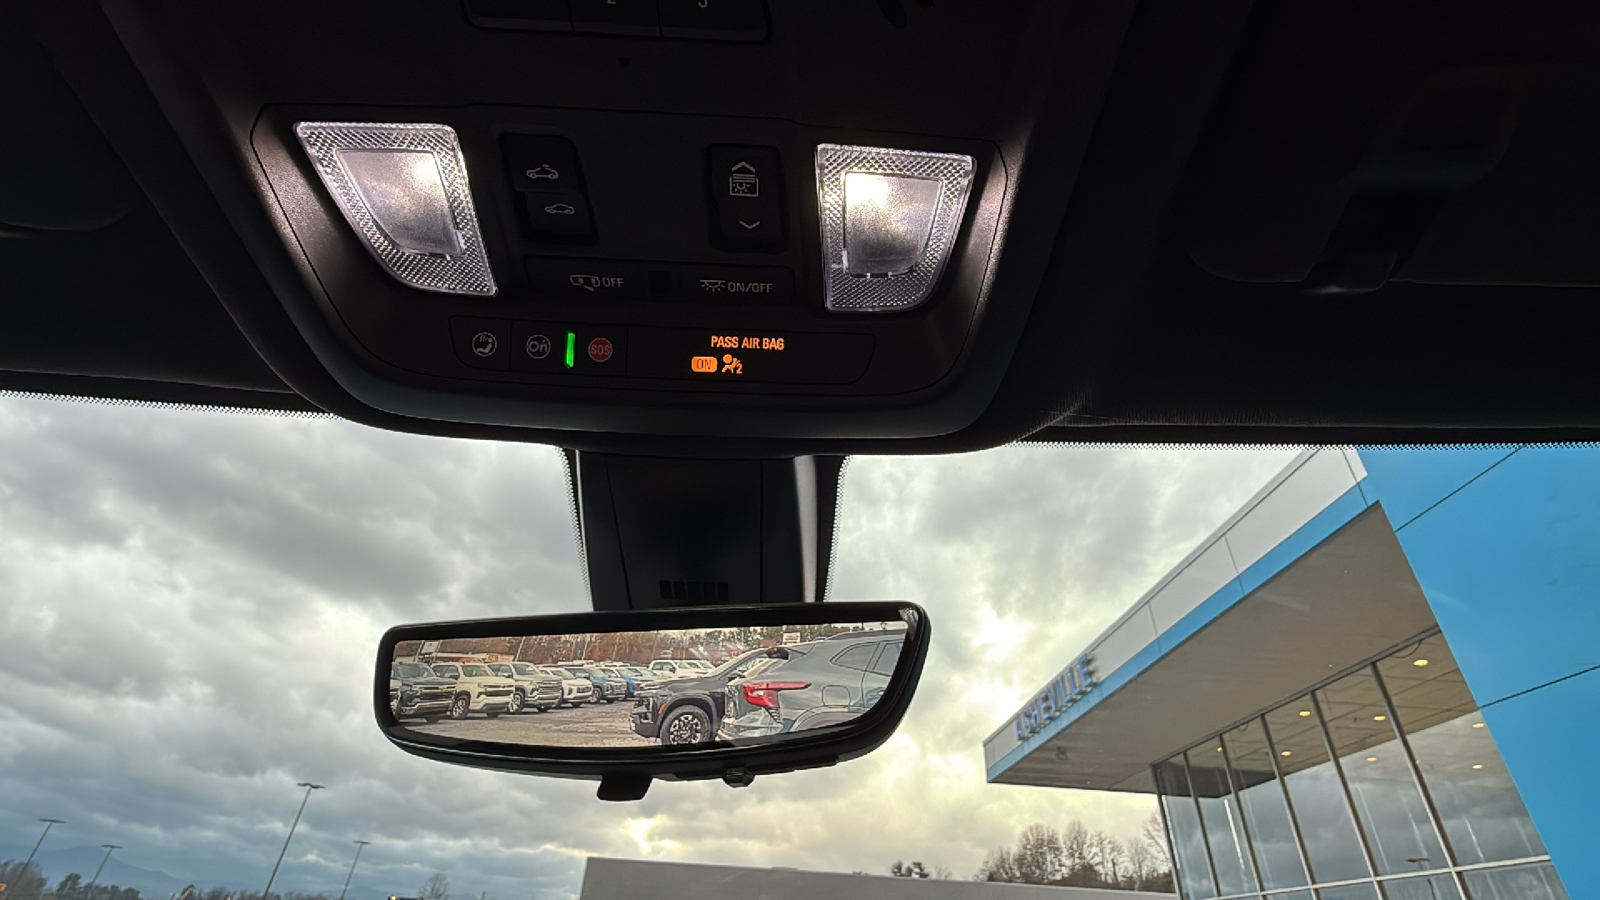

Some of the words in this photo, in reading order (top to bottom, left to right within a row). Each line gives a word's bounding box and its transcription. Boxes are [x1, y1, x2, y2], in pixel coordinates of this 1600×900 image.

[602, 277, 624, 288] OFF
[727, 282, 773, 293] ON/OFF
[528, 340, 548, 353] On
[710, 335, 739, 348] PASS
[741, 336, 760, 349] AIR
[762, 337, 785, 350] BAG
[591, 344, 611, 356] SOS
[696, 358, 712, 370] ON
[1014, 653, 1096, 741] ASHEVILLE
